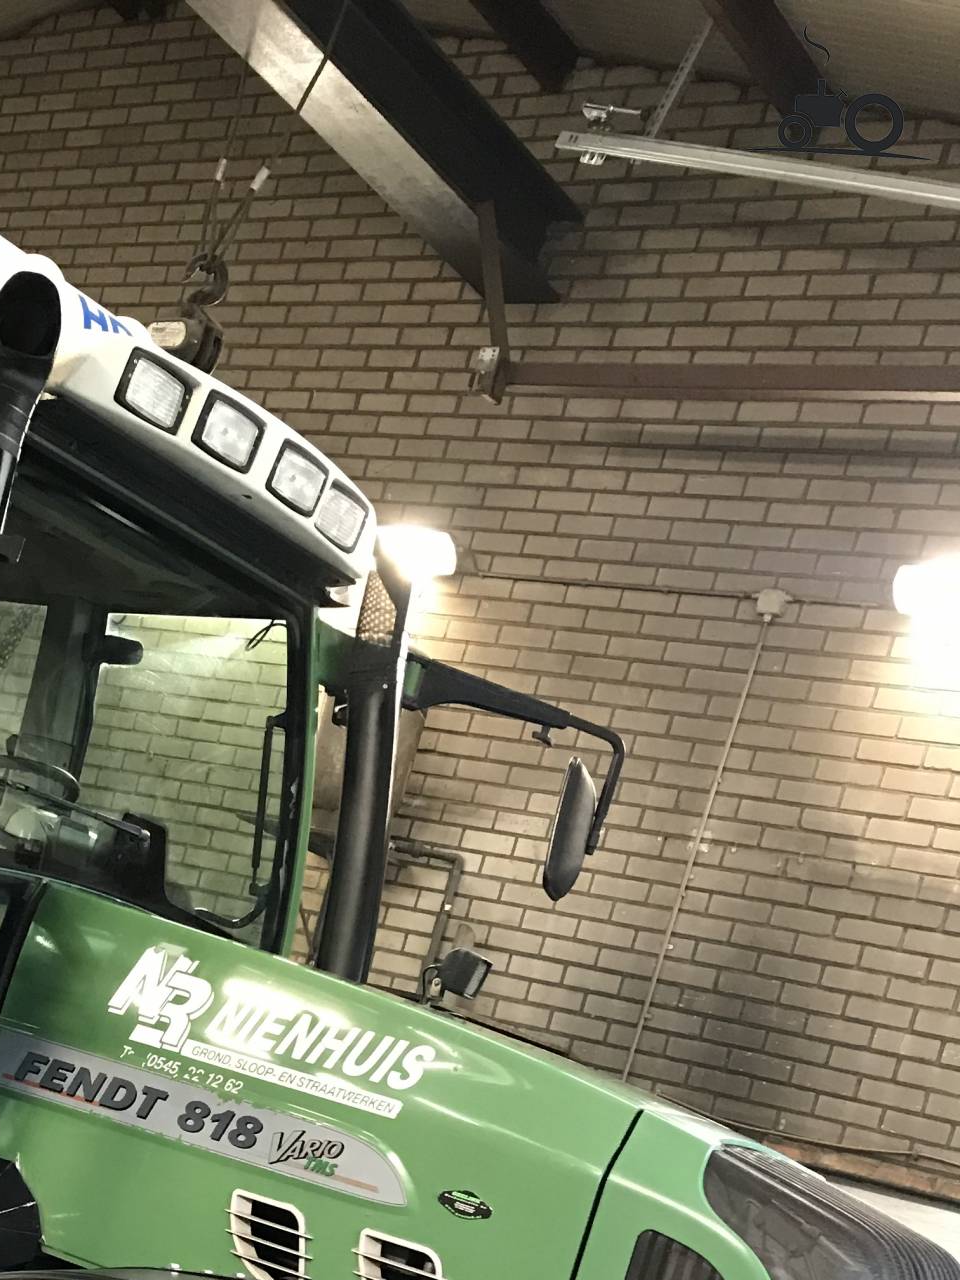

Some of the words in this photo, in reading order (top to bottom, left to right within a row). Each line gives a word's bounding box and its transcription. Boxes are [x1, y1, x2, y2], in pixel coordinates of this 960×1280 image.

[204, 995, 436, 1090] NIENHUIS
[14, 1051, 170, 1120] FENDT
[177, 1100, 264, 1150] 818
[206, 1073, 224, 1088] 12
[224, 1078, 244, 1094] 62
[278, 1071, 297, 1085] EN
[296, 1076, 396, 1114] STRAATWERKEN
